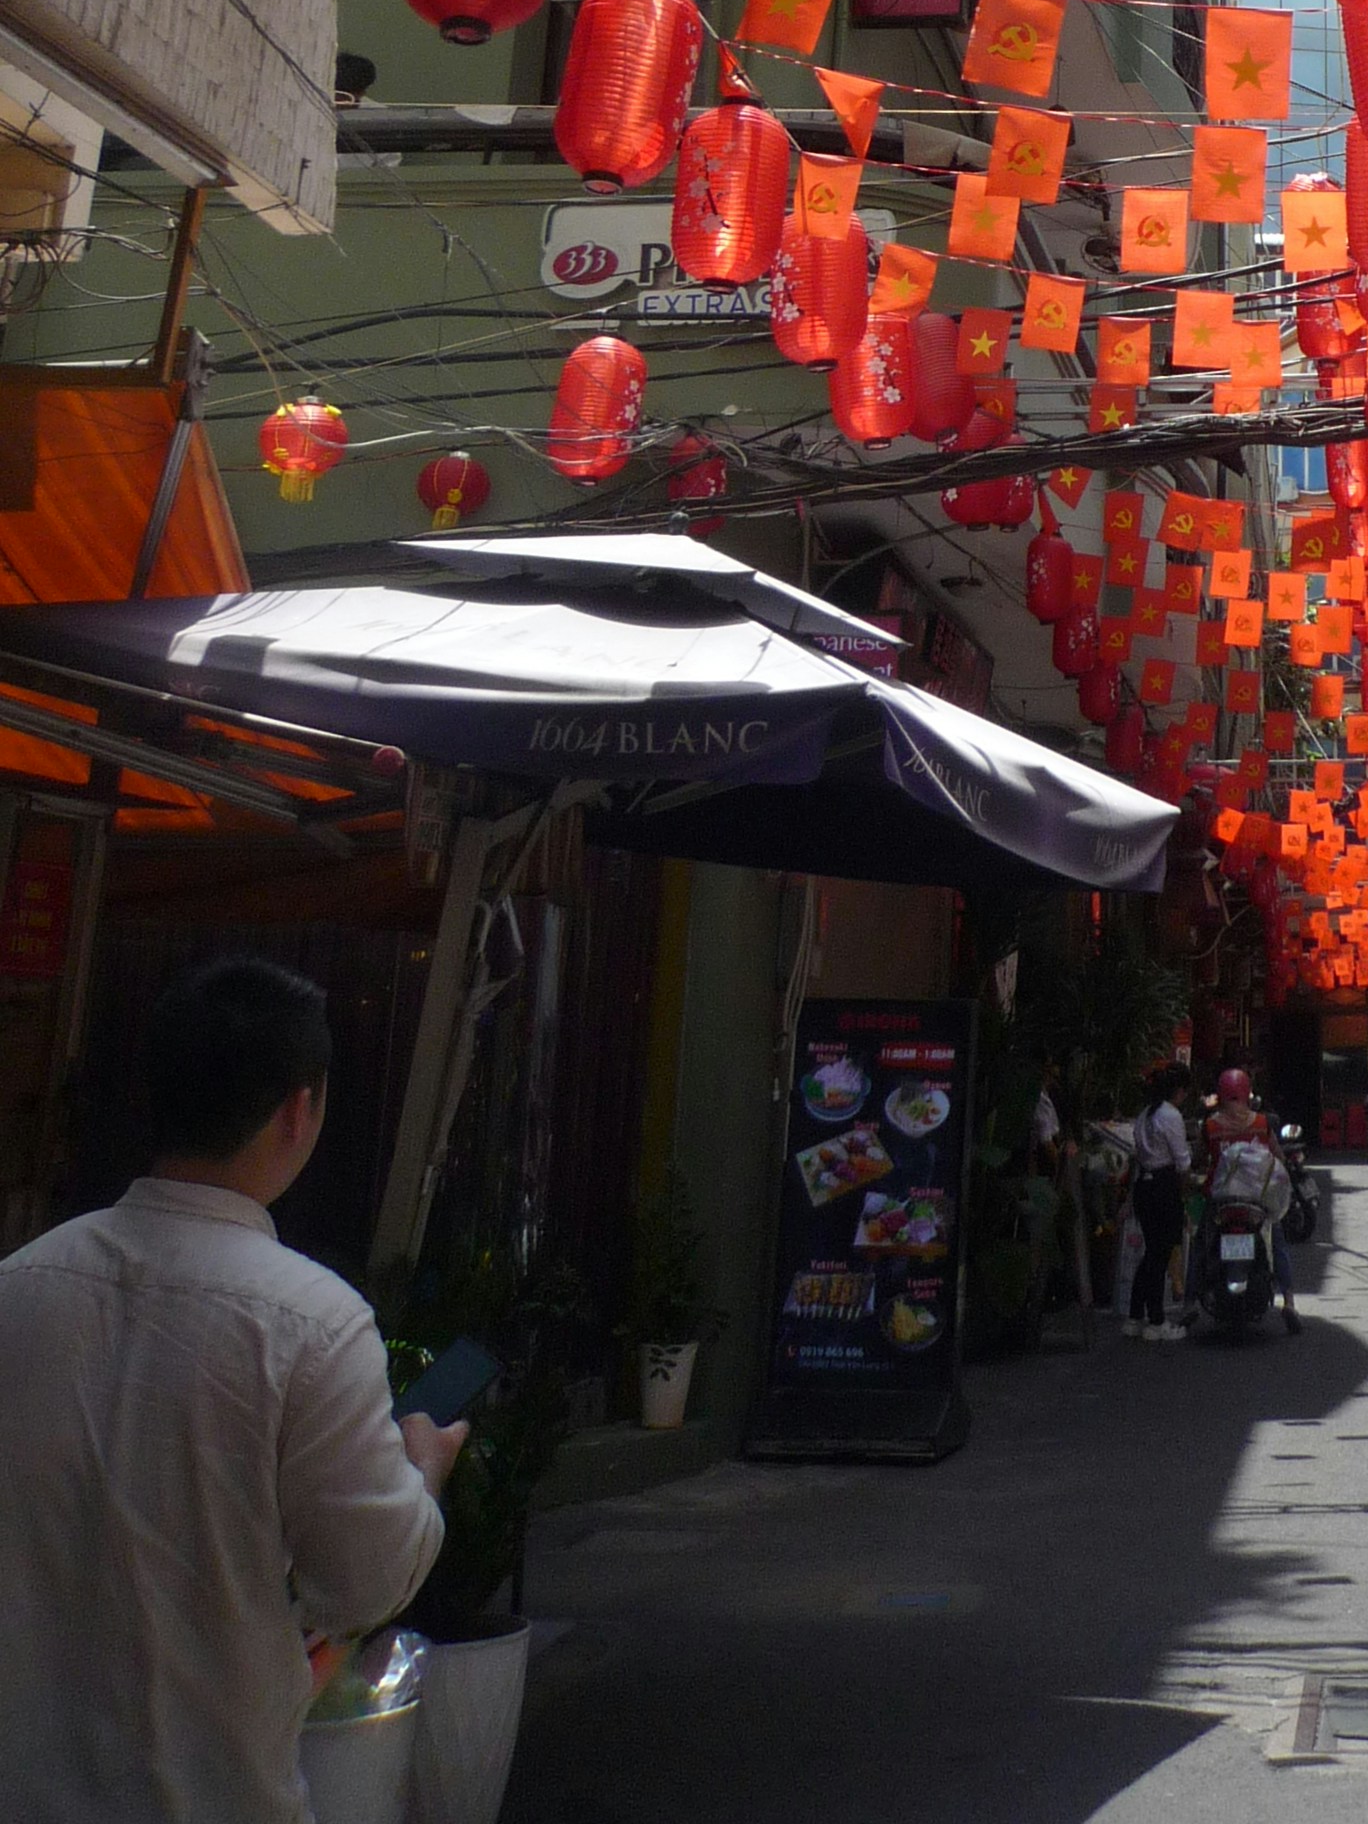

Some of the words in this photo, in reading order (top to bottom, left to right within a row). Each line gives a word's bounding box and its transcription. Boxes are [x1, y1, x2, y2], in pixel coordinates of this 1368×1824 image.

[562, 243, 607, 277] 333
[643, 293, 748, 315] EXTRA
[528, 716, 609, 756] 1664
[617, 720, 769, 754] BLANC
